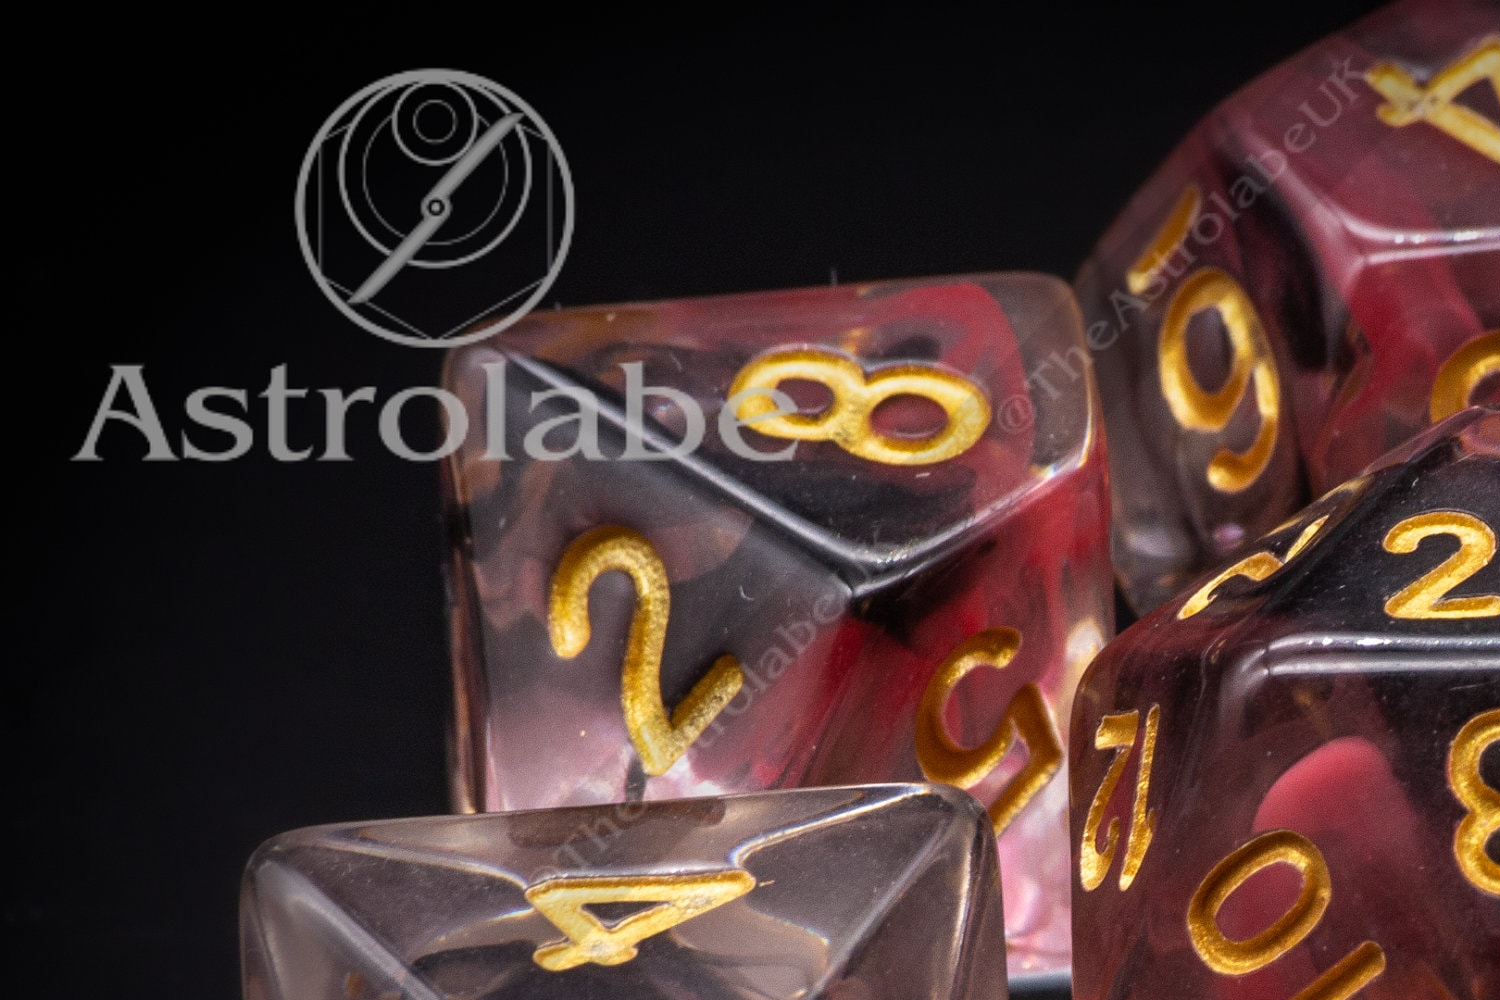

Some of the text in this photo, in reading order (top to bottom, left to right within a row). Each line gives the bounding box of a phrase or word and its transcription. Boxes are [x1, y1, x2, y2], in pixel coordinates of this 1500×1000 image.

[728, 347, 992, 466] 8
[548, 525, 744, 776] 2
[525, 868, 757, 973] 4
